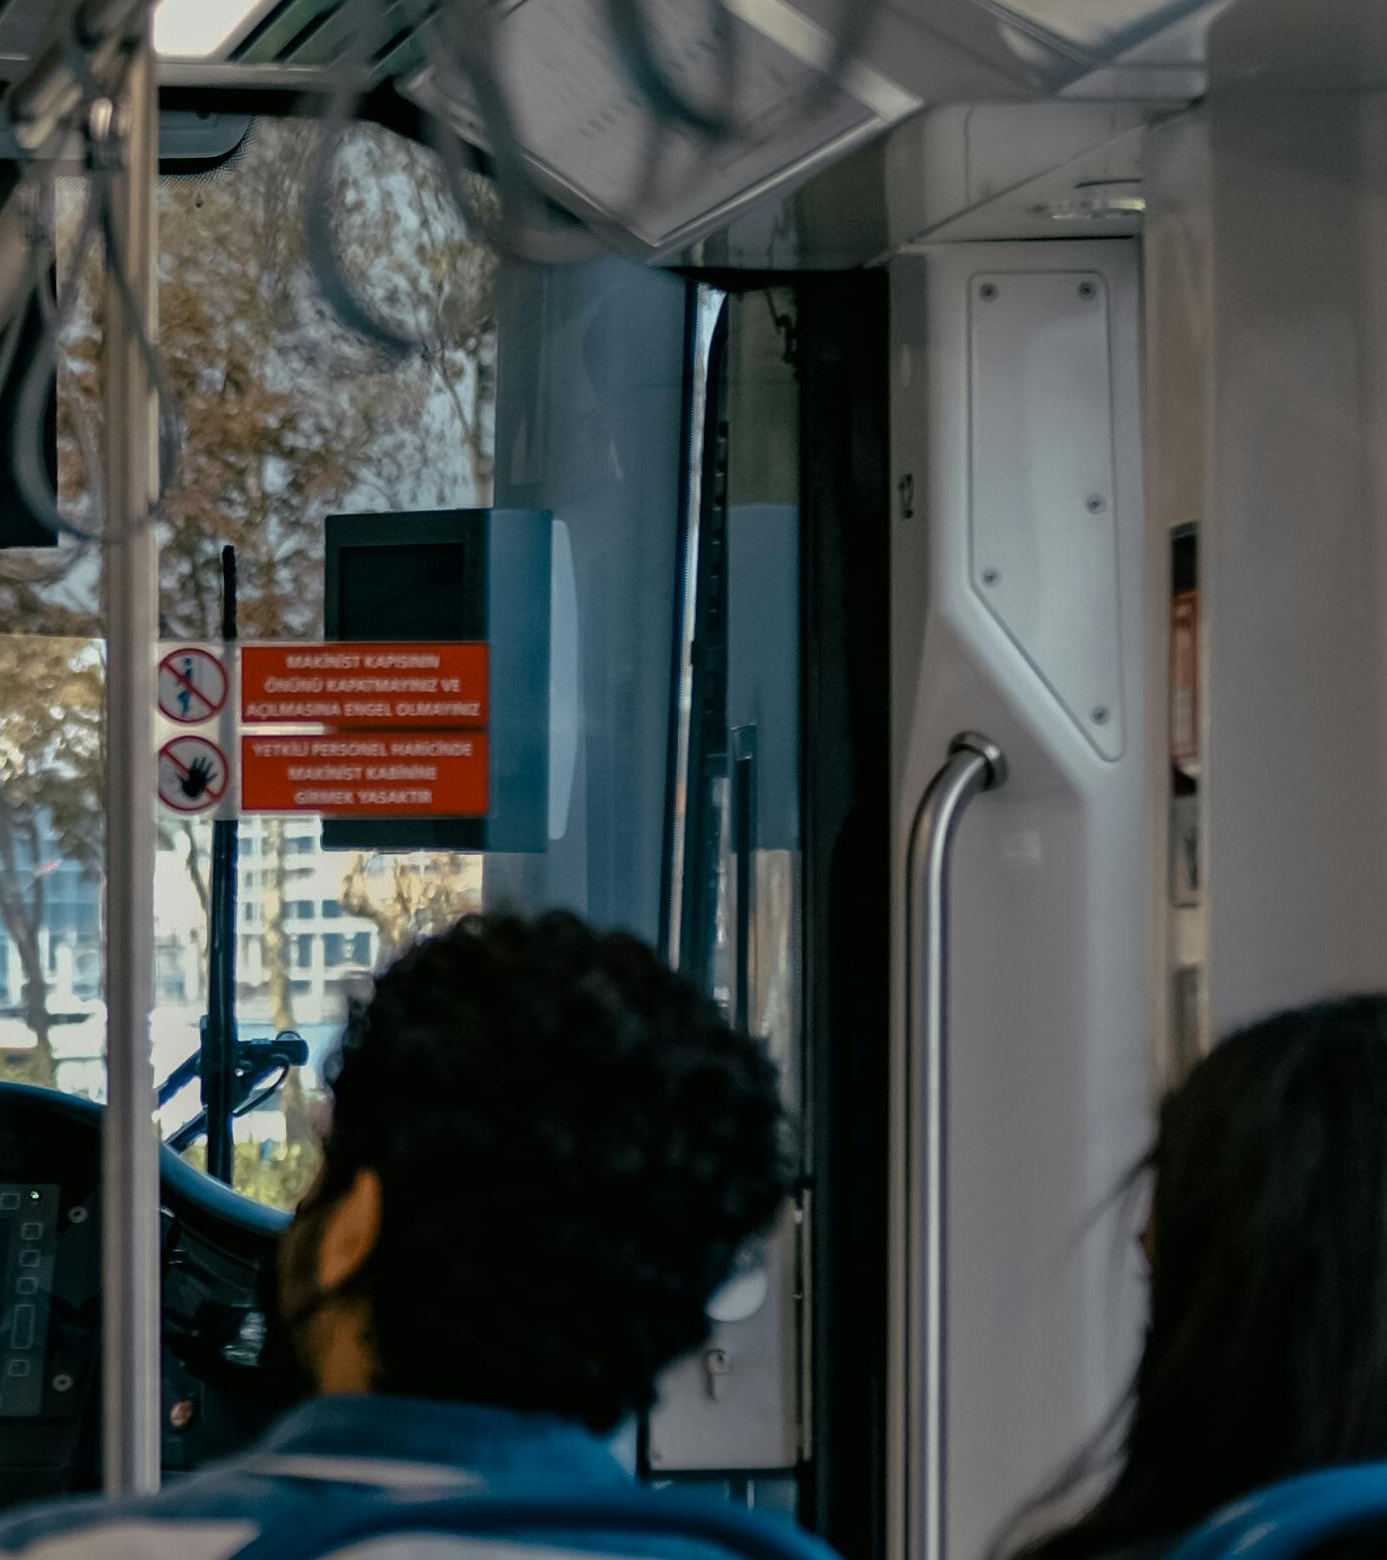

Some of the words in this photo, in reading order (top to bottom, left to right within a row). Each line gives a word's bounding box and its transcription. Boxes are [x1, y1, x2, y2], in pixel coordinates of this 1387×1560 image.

[440, 678, 461, 693] VE
[344, 702, 392, 717] ENGEL
[311, 742, 388, 757] PERSONEL
